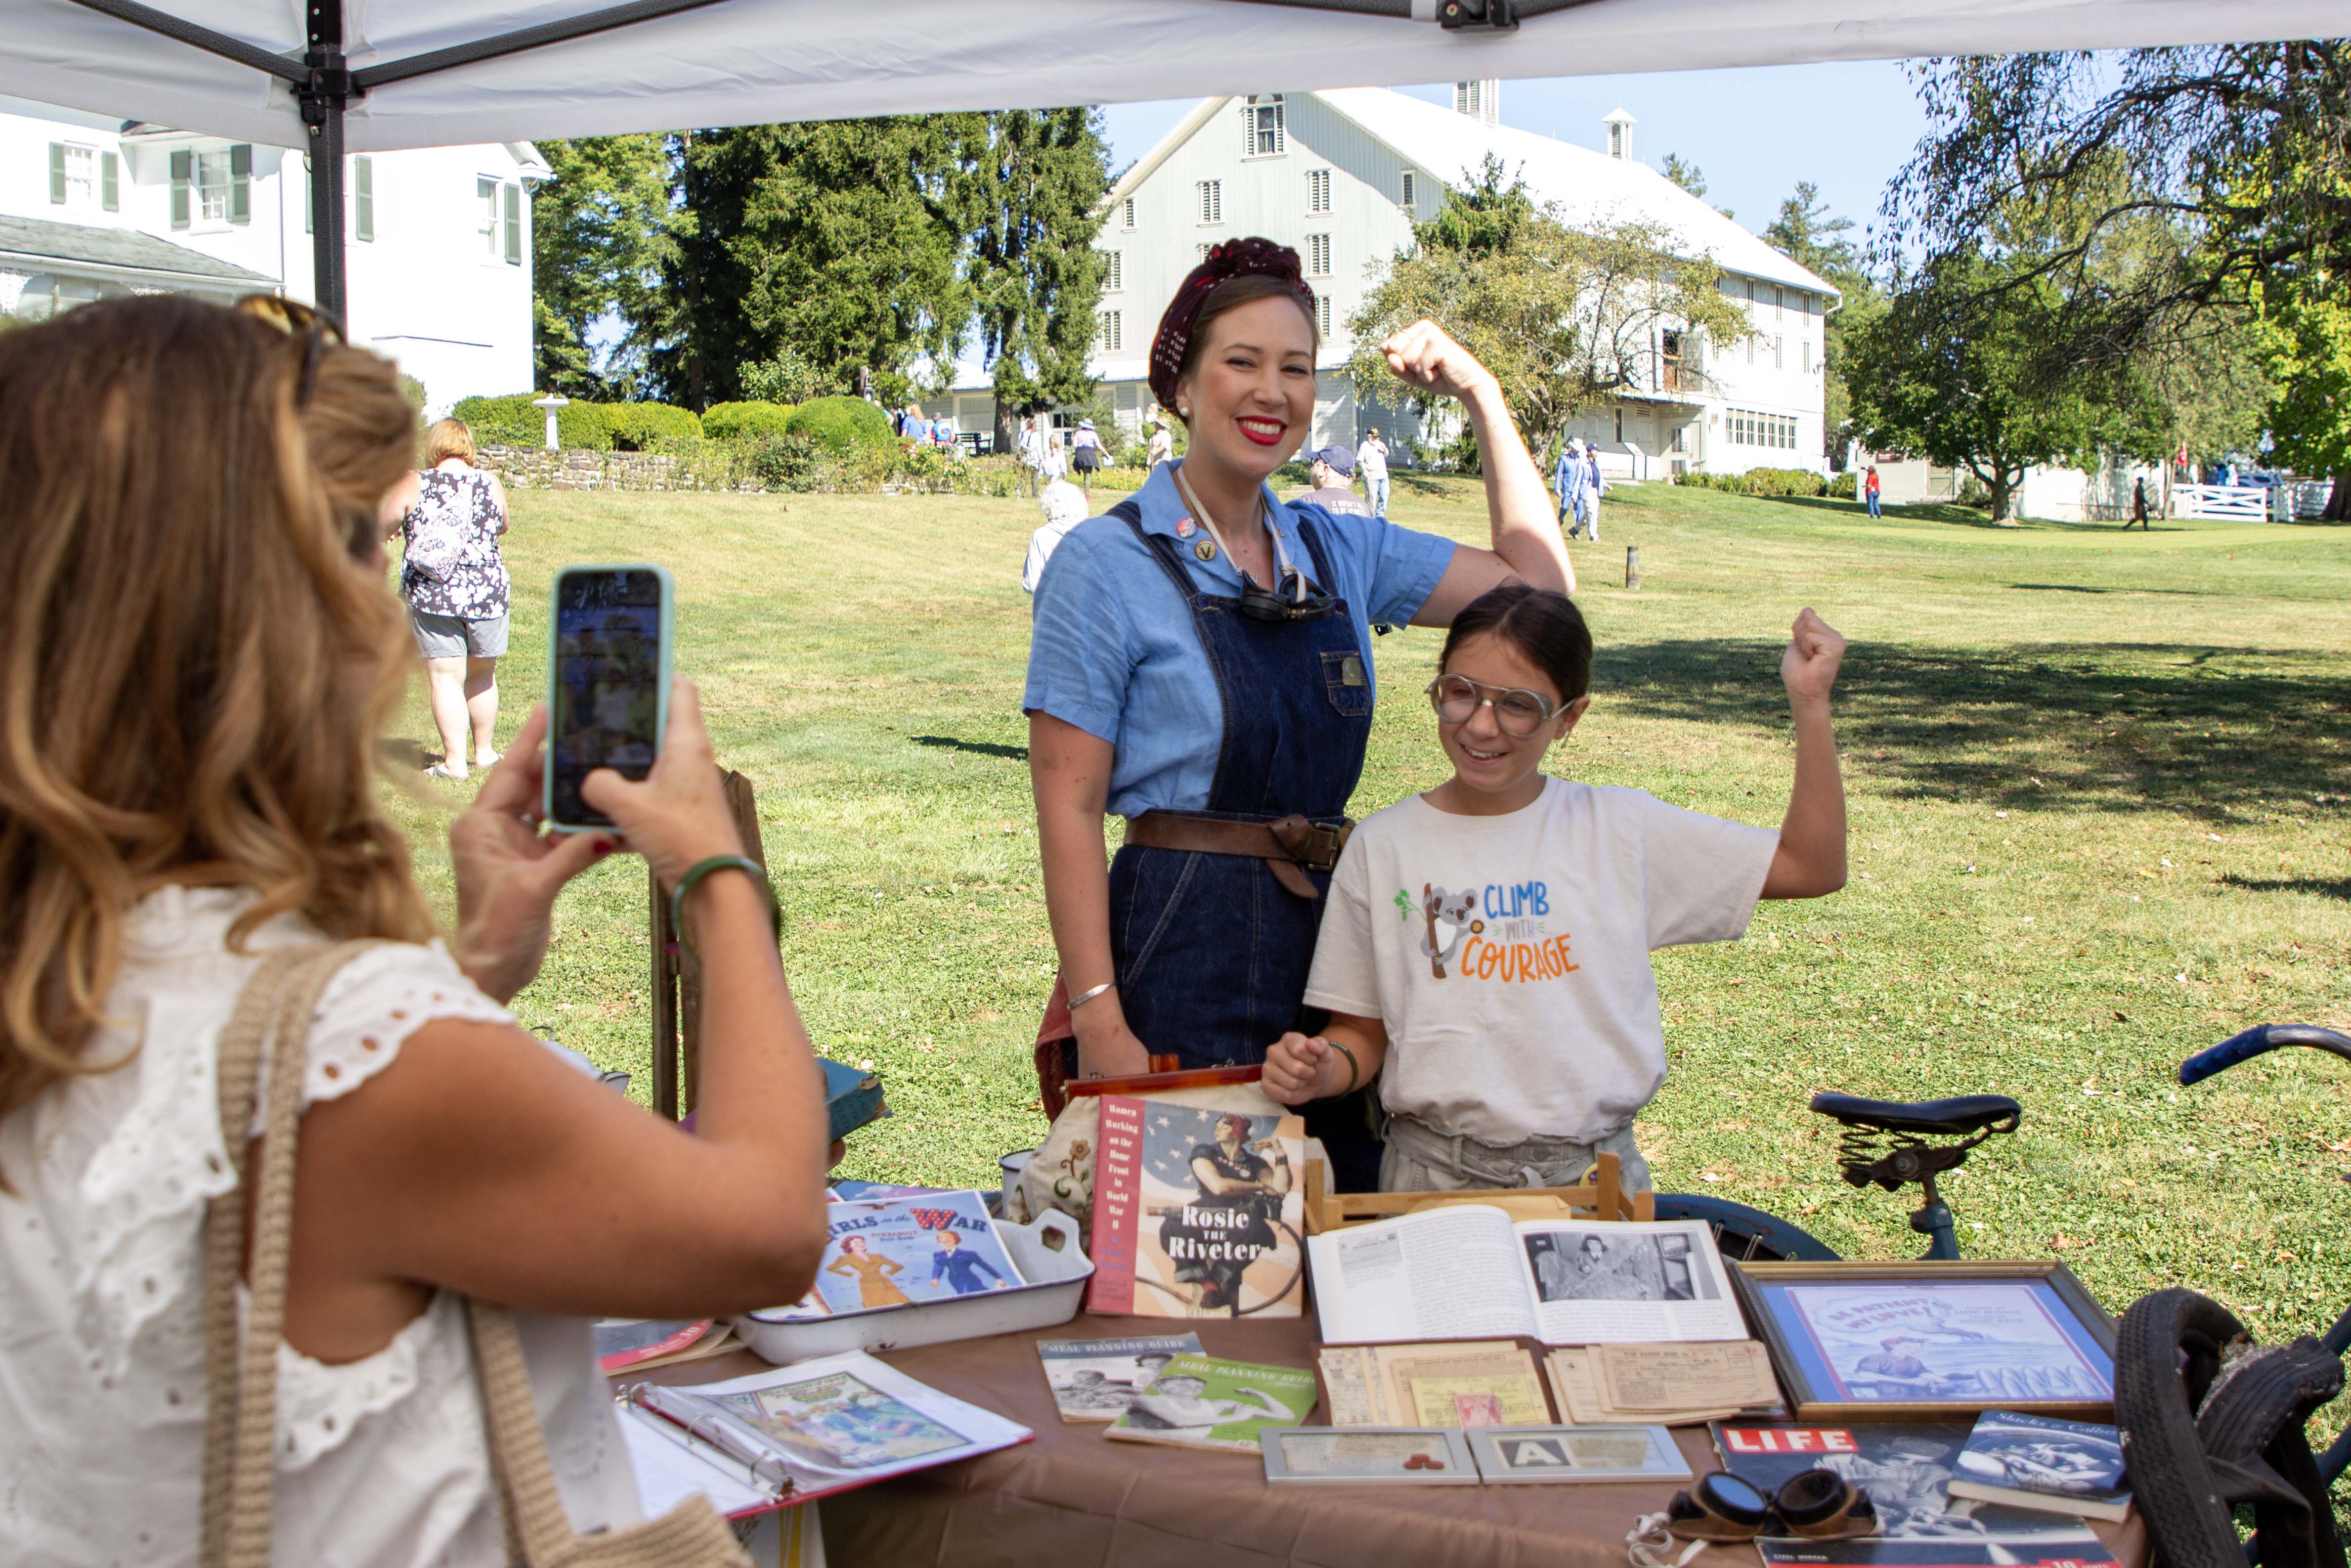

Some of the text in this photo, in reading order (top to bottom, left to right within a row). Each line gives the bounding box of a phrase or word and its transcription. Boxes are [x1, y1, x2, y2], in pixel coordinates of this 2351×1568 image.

[1200, 546, 1211, 559] V
[1483, 880, 1550, 919] CLIMB
[1505, 918, 1534, 941] WITH
[1461, 933, 1580, 983] COURAGE
[1109, 1104, 1136, 1117] Women
[1105, 1119, 1138, 1134] Working
[1121, 1137, 1132, 1147] the
[1110, 1149, 1130, 1161] Home
[1109, 1164, 1129, 1175] Front
[1114, 1177, 1122, 1187] in
[1106, 1190, 1128, 1202] World
[1109, 1205, 1124, 1216] War
[1182, 1206, 1249, 1229] Rosie
[827, 1216, 878, 1234] IRLS
[896, 1214, 913, 1222] the
[910, 1208, 987, 1232] WAR
[1203, 1230, 1226, 1241] THE
[1169, 1236, 1261, 1261] Riveter
[1828, 1298, 1928, 1321] BE PATIENT
[1845, 1317, 1872, 1328] MY
[1047, 1344, 1081, 1353] MEAL
[1085, 1342, 1144, 1352] PLANNING
[1149, 1340, 1185, 1349] GUIDE
[1179, 1360, 1210, 1373] MEAL
[1216, 1366, 1276, 1380] PLANNING
[1997, 1412, 2046, 1428] Slacks
[2068, 1424, 2117, 1435] Callus
[1727, 1430, 1854, 1450] LIFE
[1514, 1441, 1564, 1467] A
